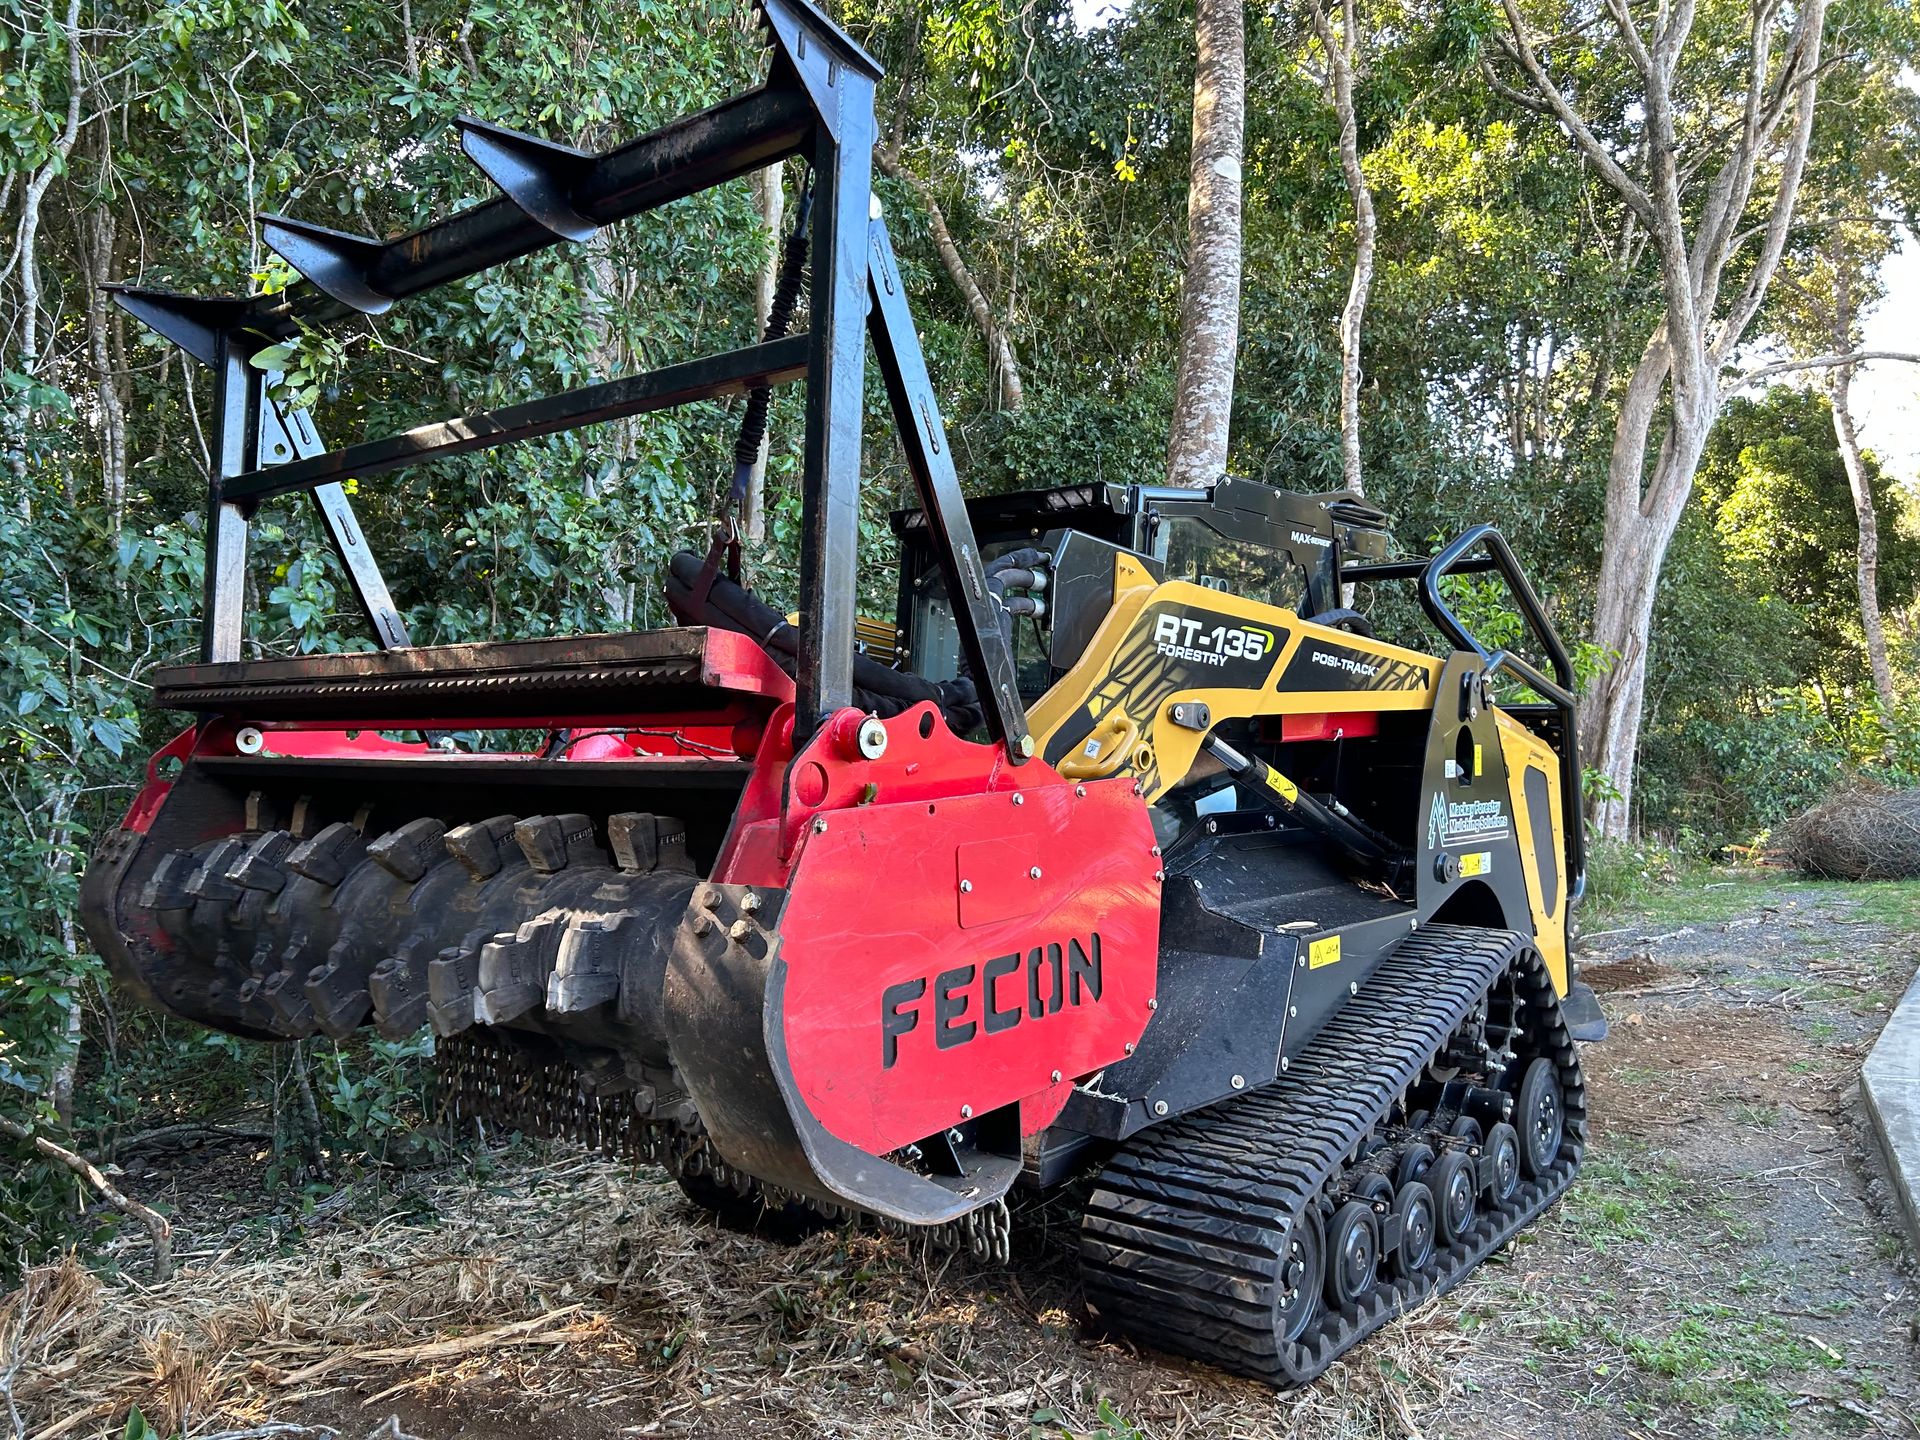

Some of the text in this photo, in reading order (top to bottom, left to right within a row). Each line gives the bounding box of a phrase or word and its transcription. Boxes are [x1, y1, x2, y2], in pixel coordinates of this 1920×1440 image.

[1153, 613, 1266, 661] RT-135
[1156, 642, 1229, 667] FORESTRY
[1449, 800, 1501, 818] Mackay Forestry
[1449, 815, 1508, 833] Mulching Solutions
[882, 932, 1103, 1070] FECON
